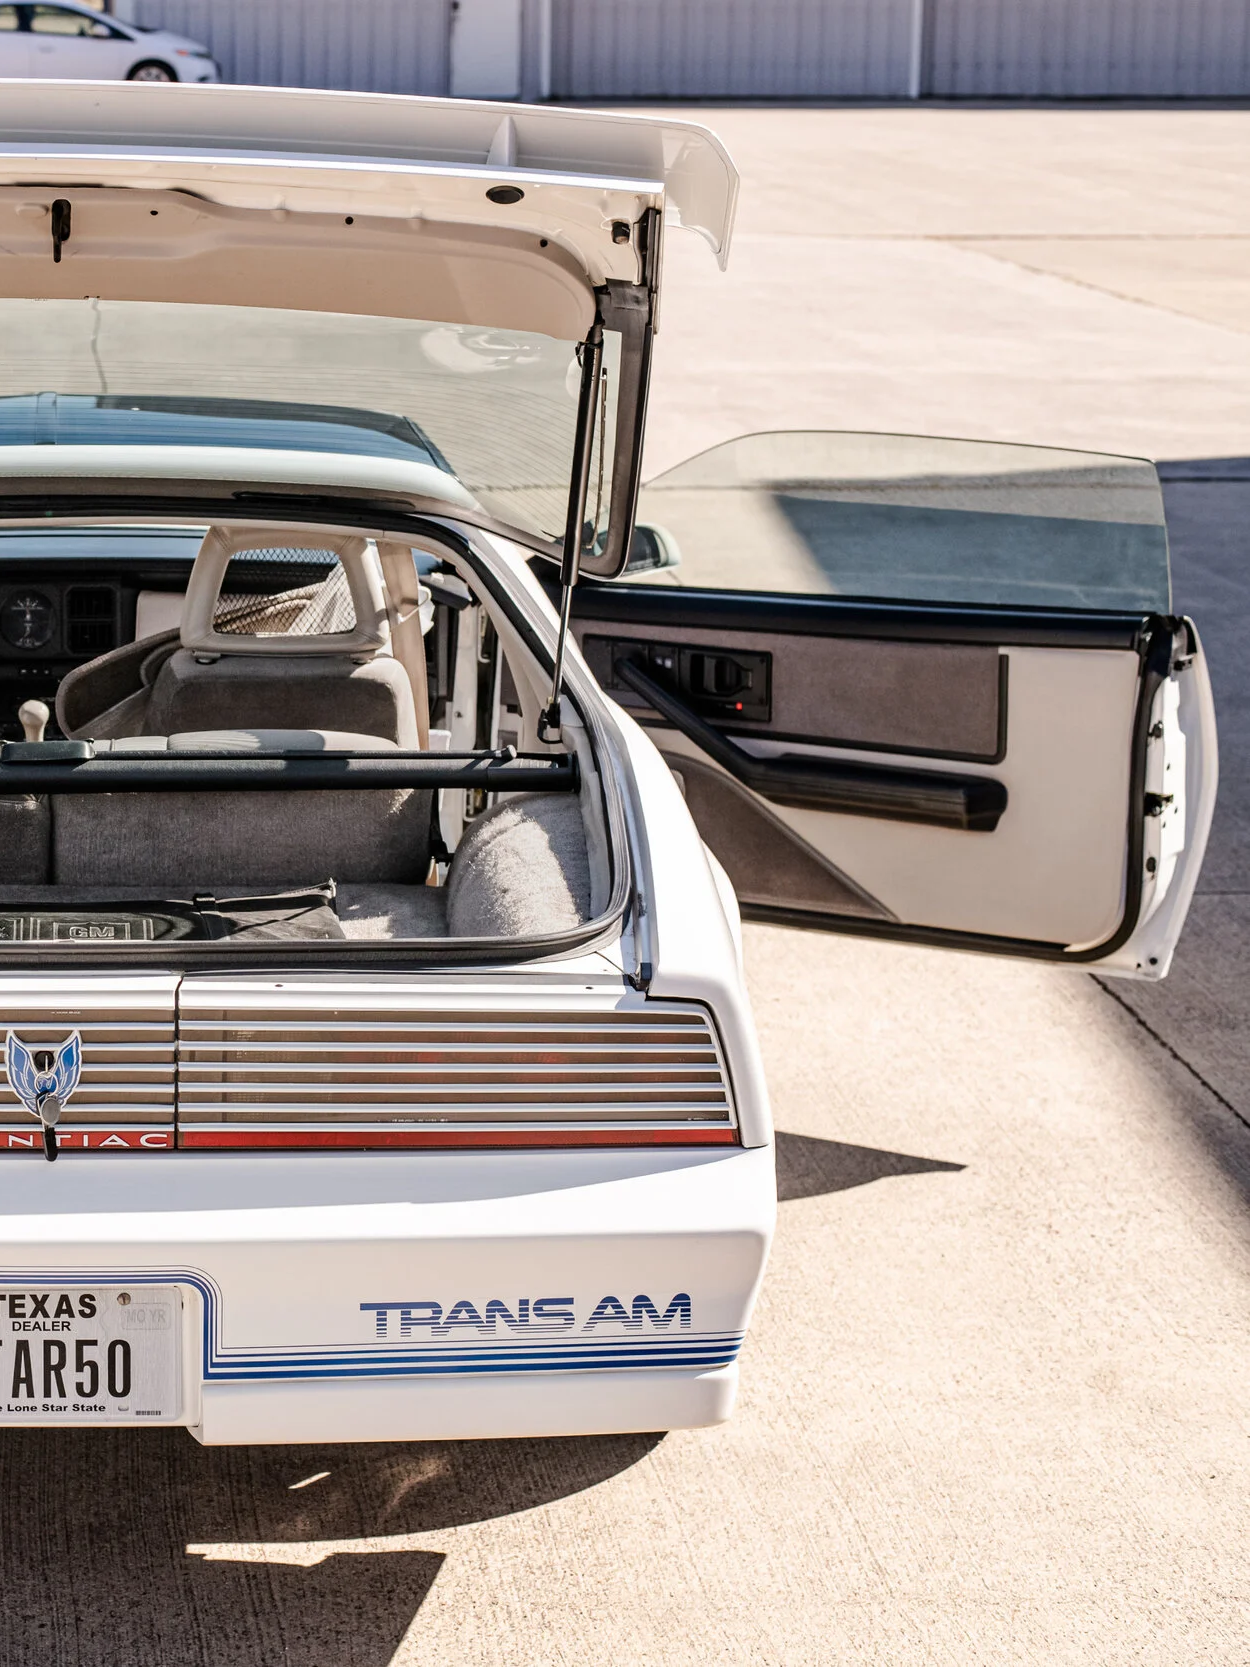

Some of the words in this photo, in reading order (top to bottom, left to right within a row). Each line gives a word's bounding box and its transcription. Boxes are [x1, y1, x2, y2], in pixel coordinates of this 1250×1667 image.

[359, 1297, 575, 1338] TRANS
[580, 1292, 692, 1331] AM
[12, 1321, 71, 1332] DEALER
[7, 1403, 37, 1413] Lone
[41, 1403, 68, 1413] Star
[72, 1403, 106, 1413] State
